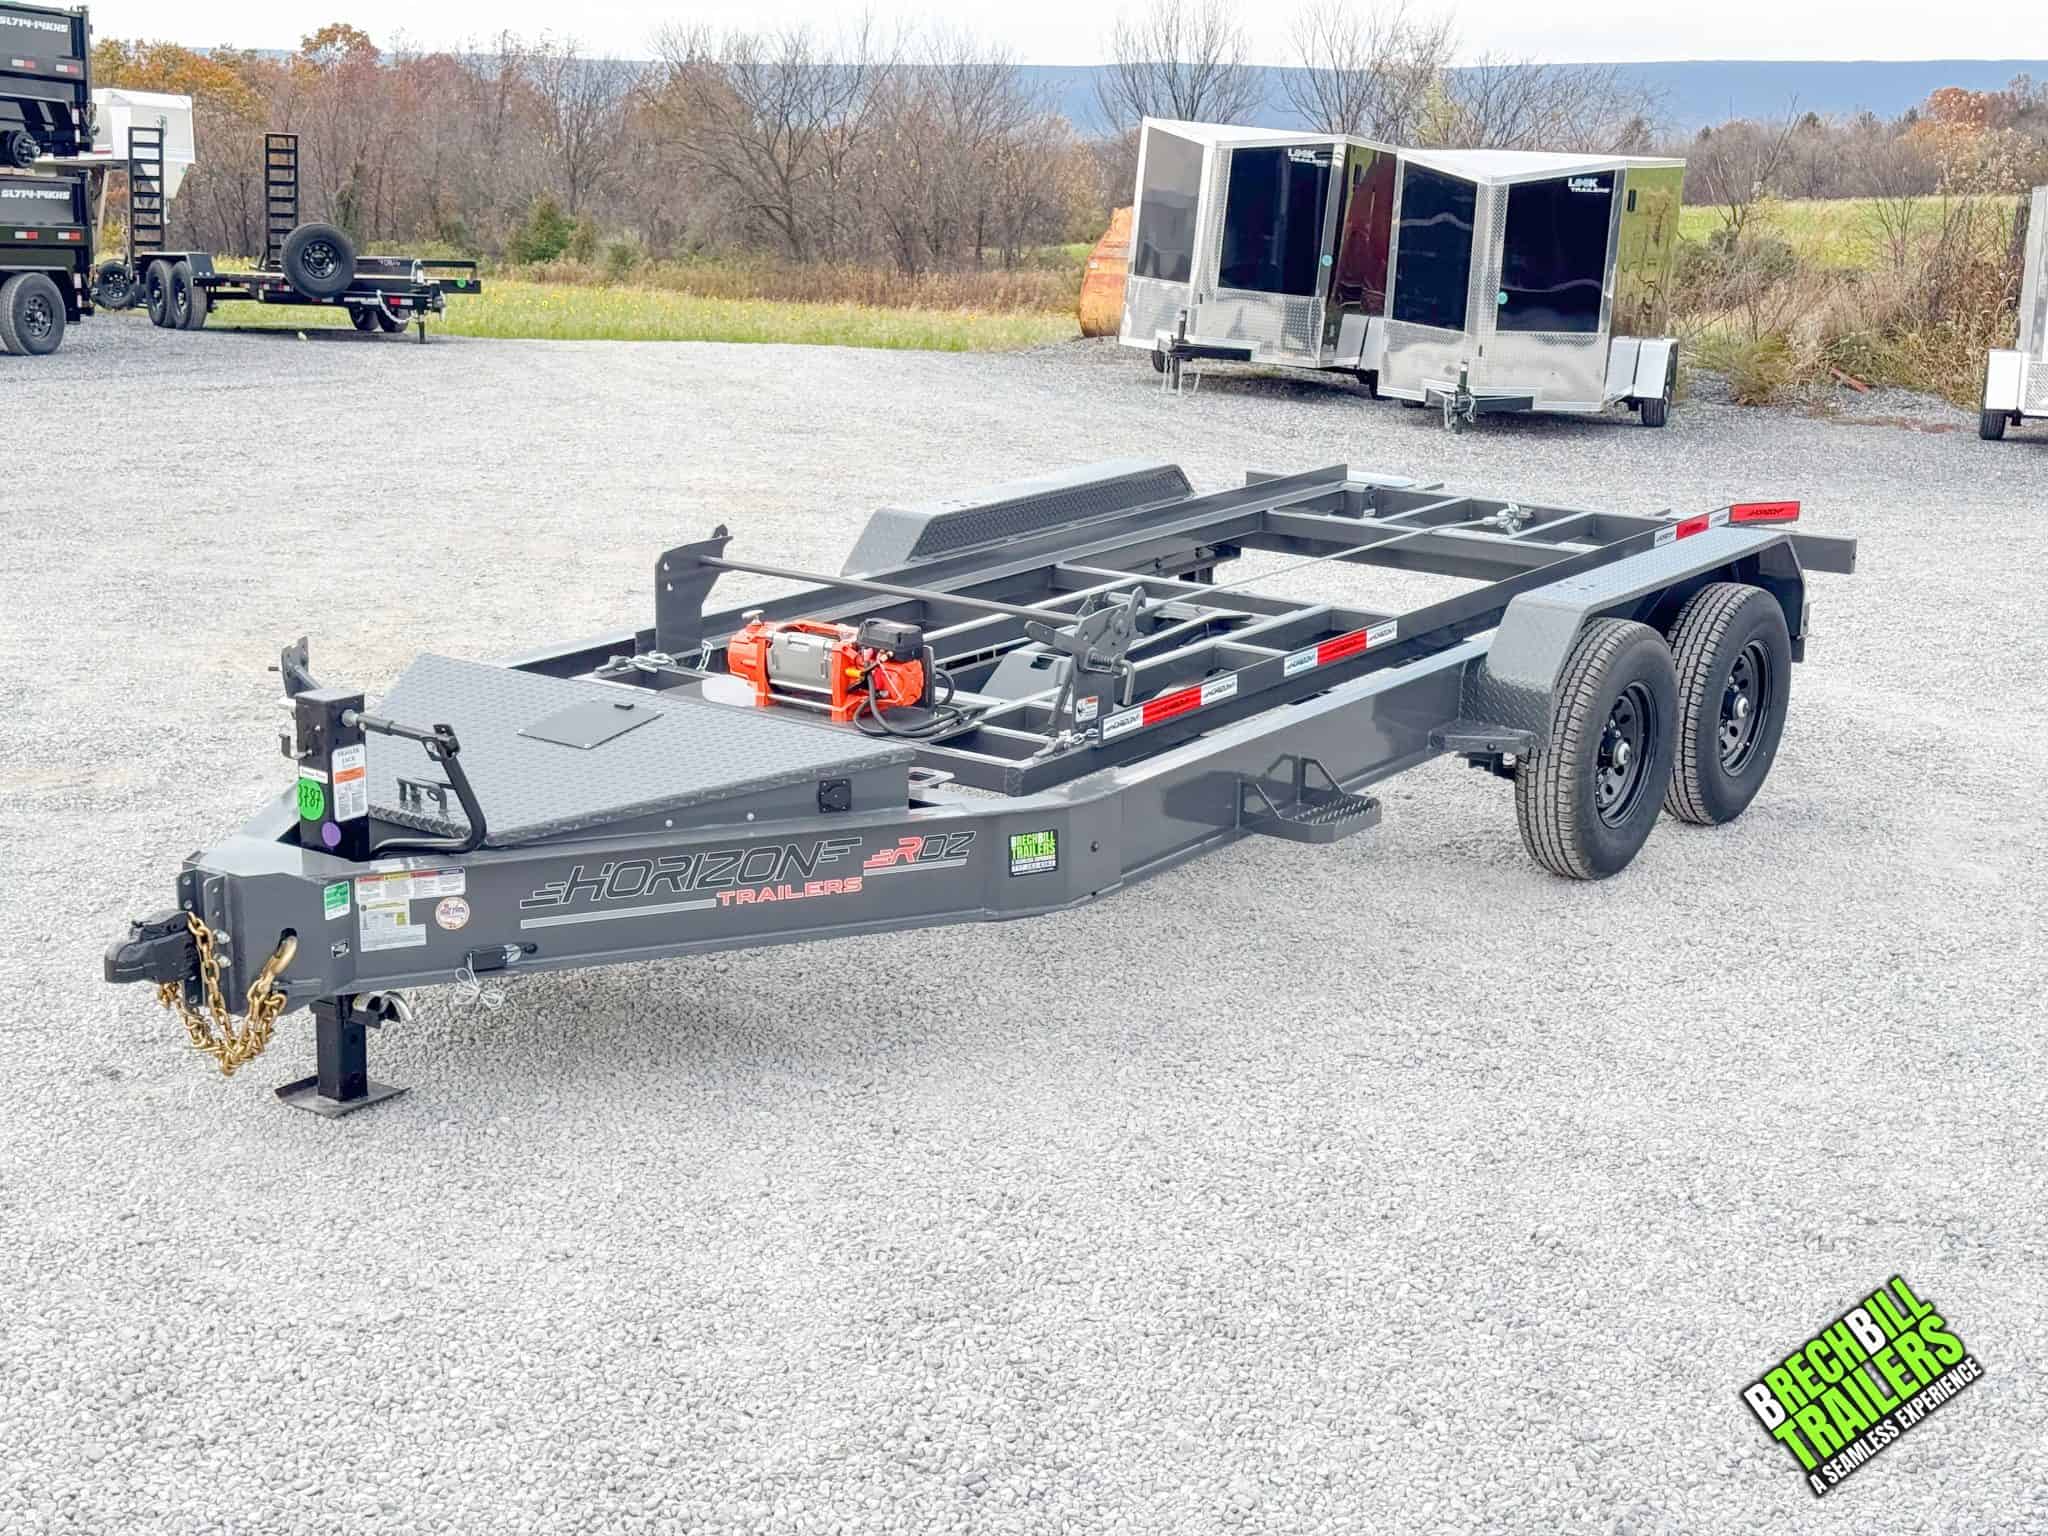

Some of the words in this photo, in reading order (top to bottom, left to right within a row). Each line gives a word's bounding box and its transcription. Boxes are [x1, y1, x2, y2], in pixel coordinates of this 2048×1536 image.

[886, 830, 977, 865] RDZ
[1011, 839, 1057, 861] TRAILERS
[559, 841, 826, 906] HORIZON
[716, 876, 863, 907] TRAILERS
